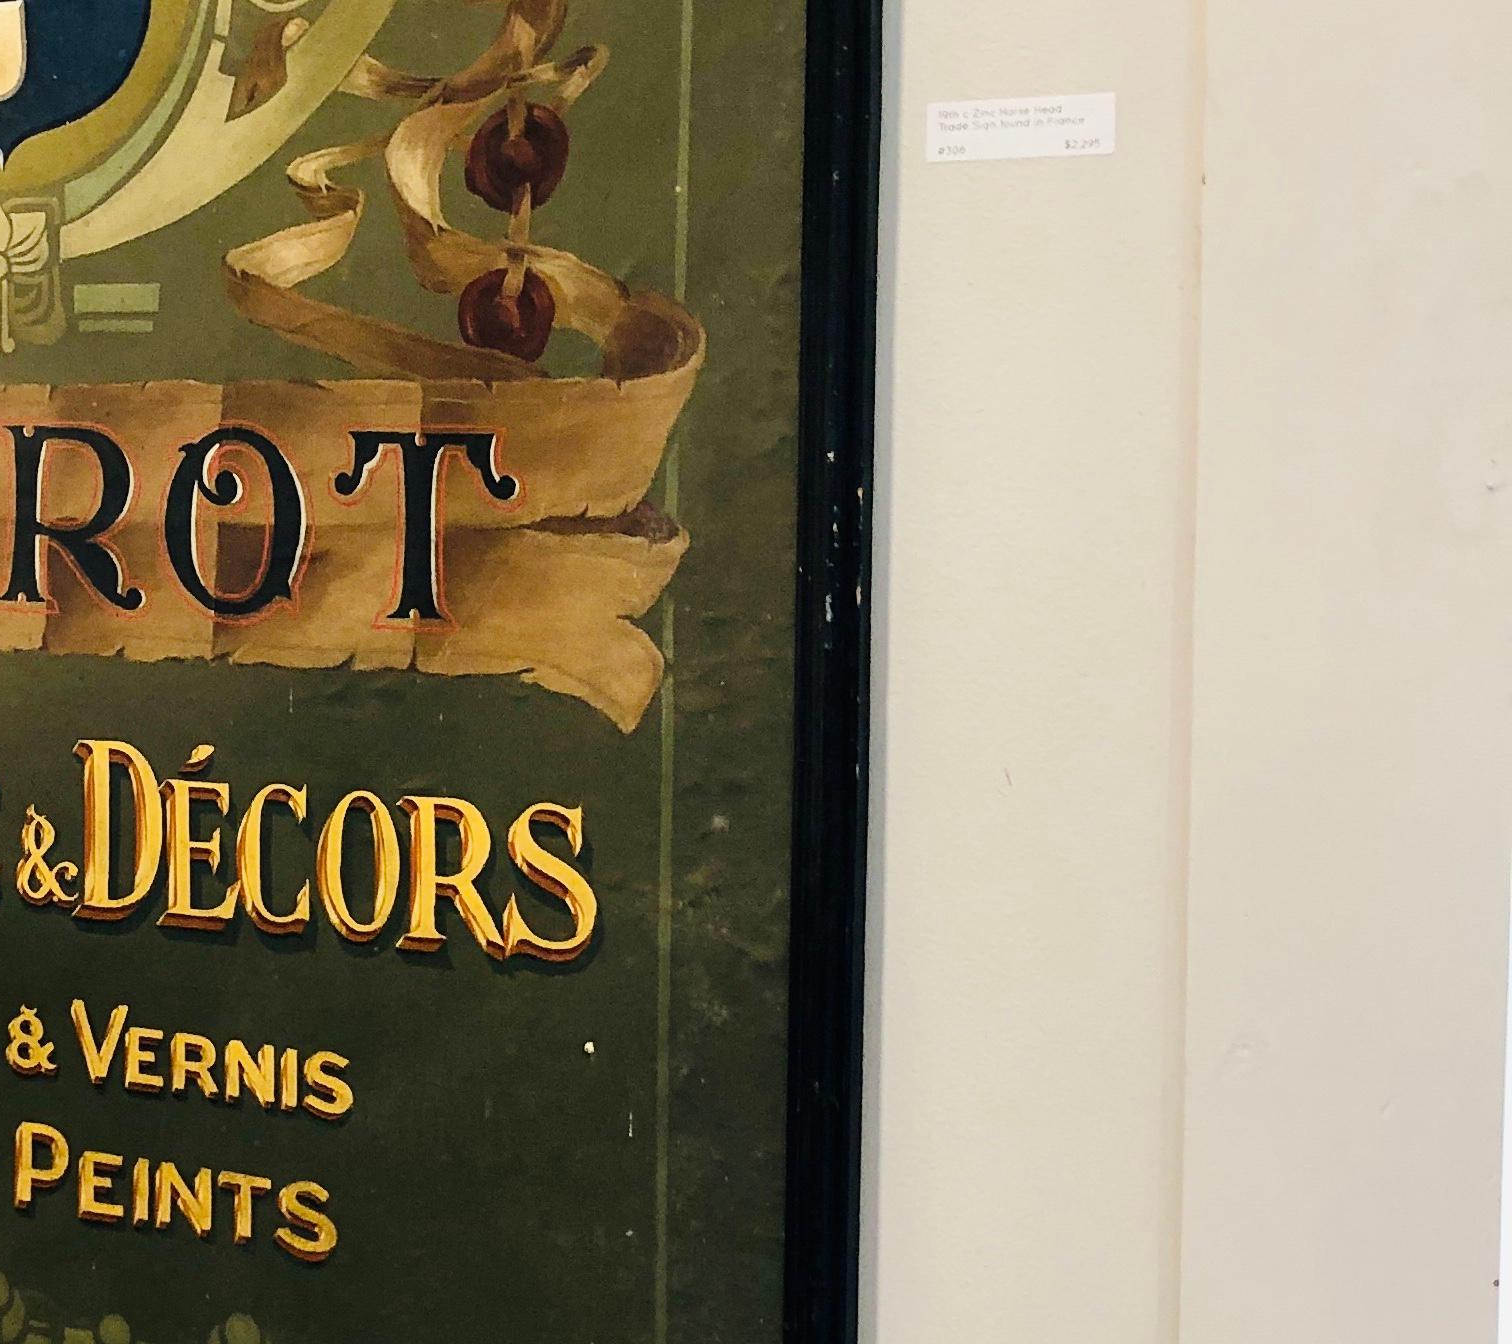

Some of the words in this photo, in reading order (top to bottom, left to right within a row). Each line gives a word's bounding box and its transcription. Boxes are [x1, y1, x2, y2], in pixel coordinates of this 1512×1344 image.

[939, 121, 968, 131] Trade
[72, 739, 598, 963] DÉCORS
[6, 1005, 56, 1076] &
[70, 999, 355, 1122] VERNIS
